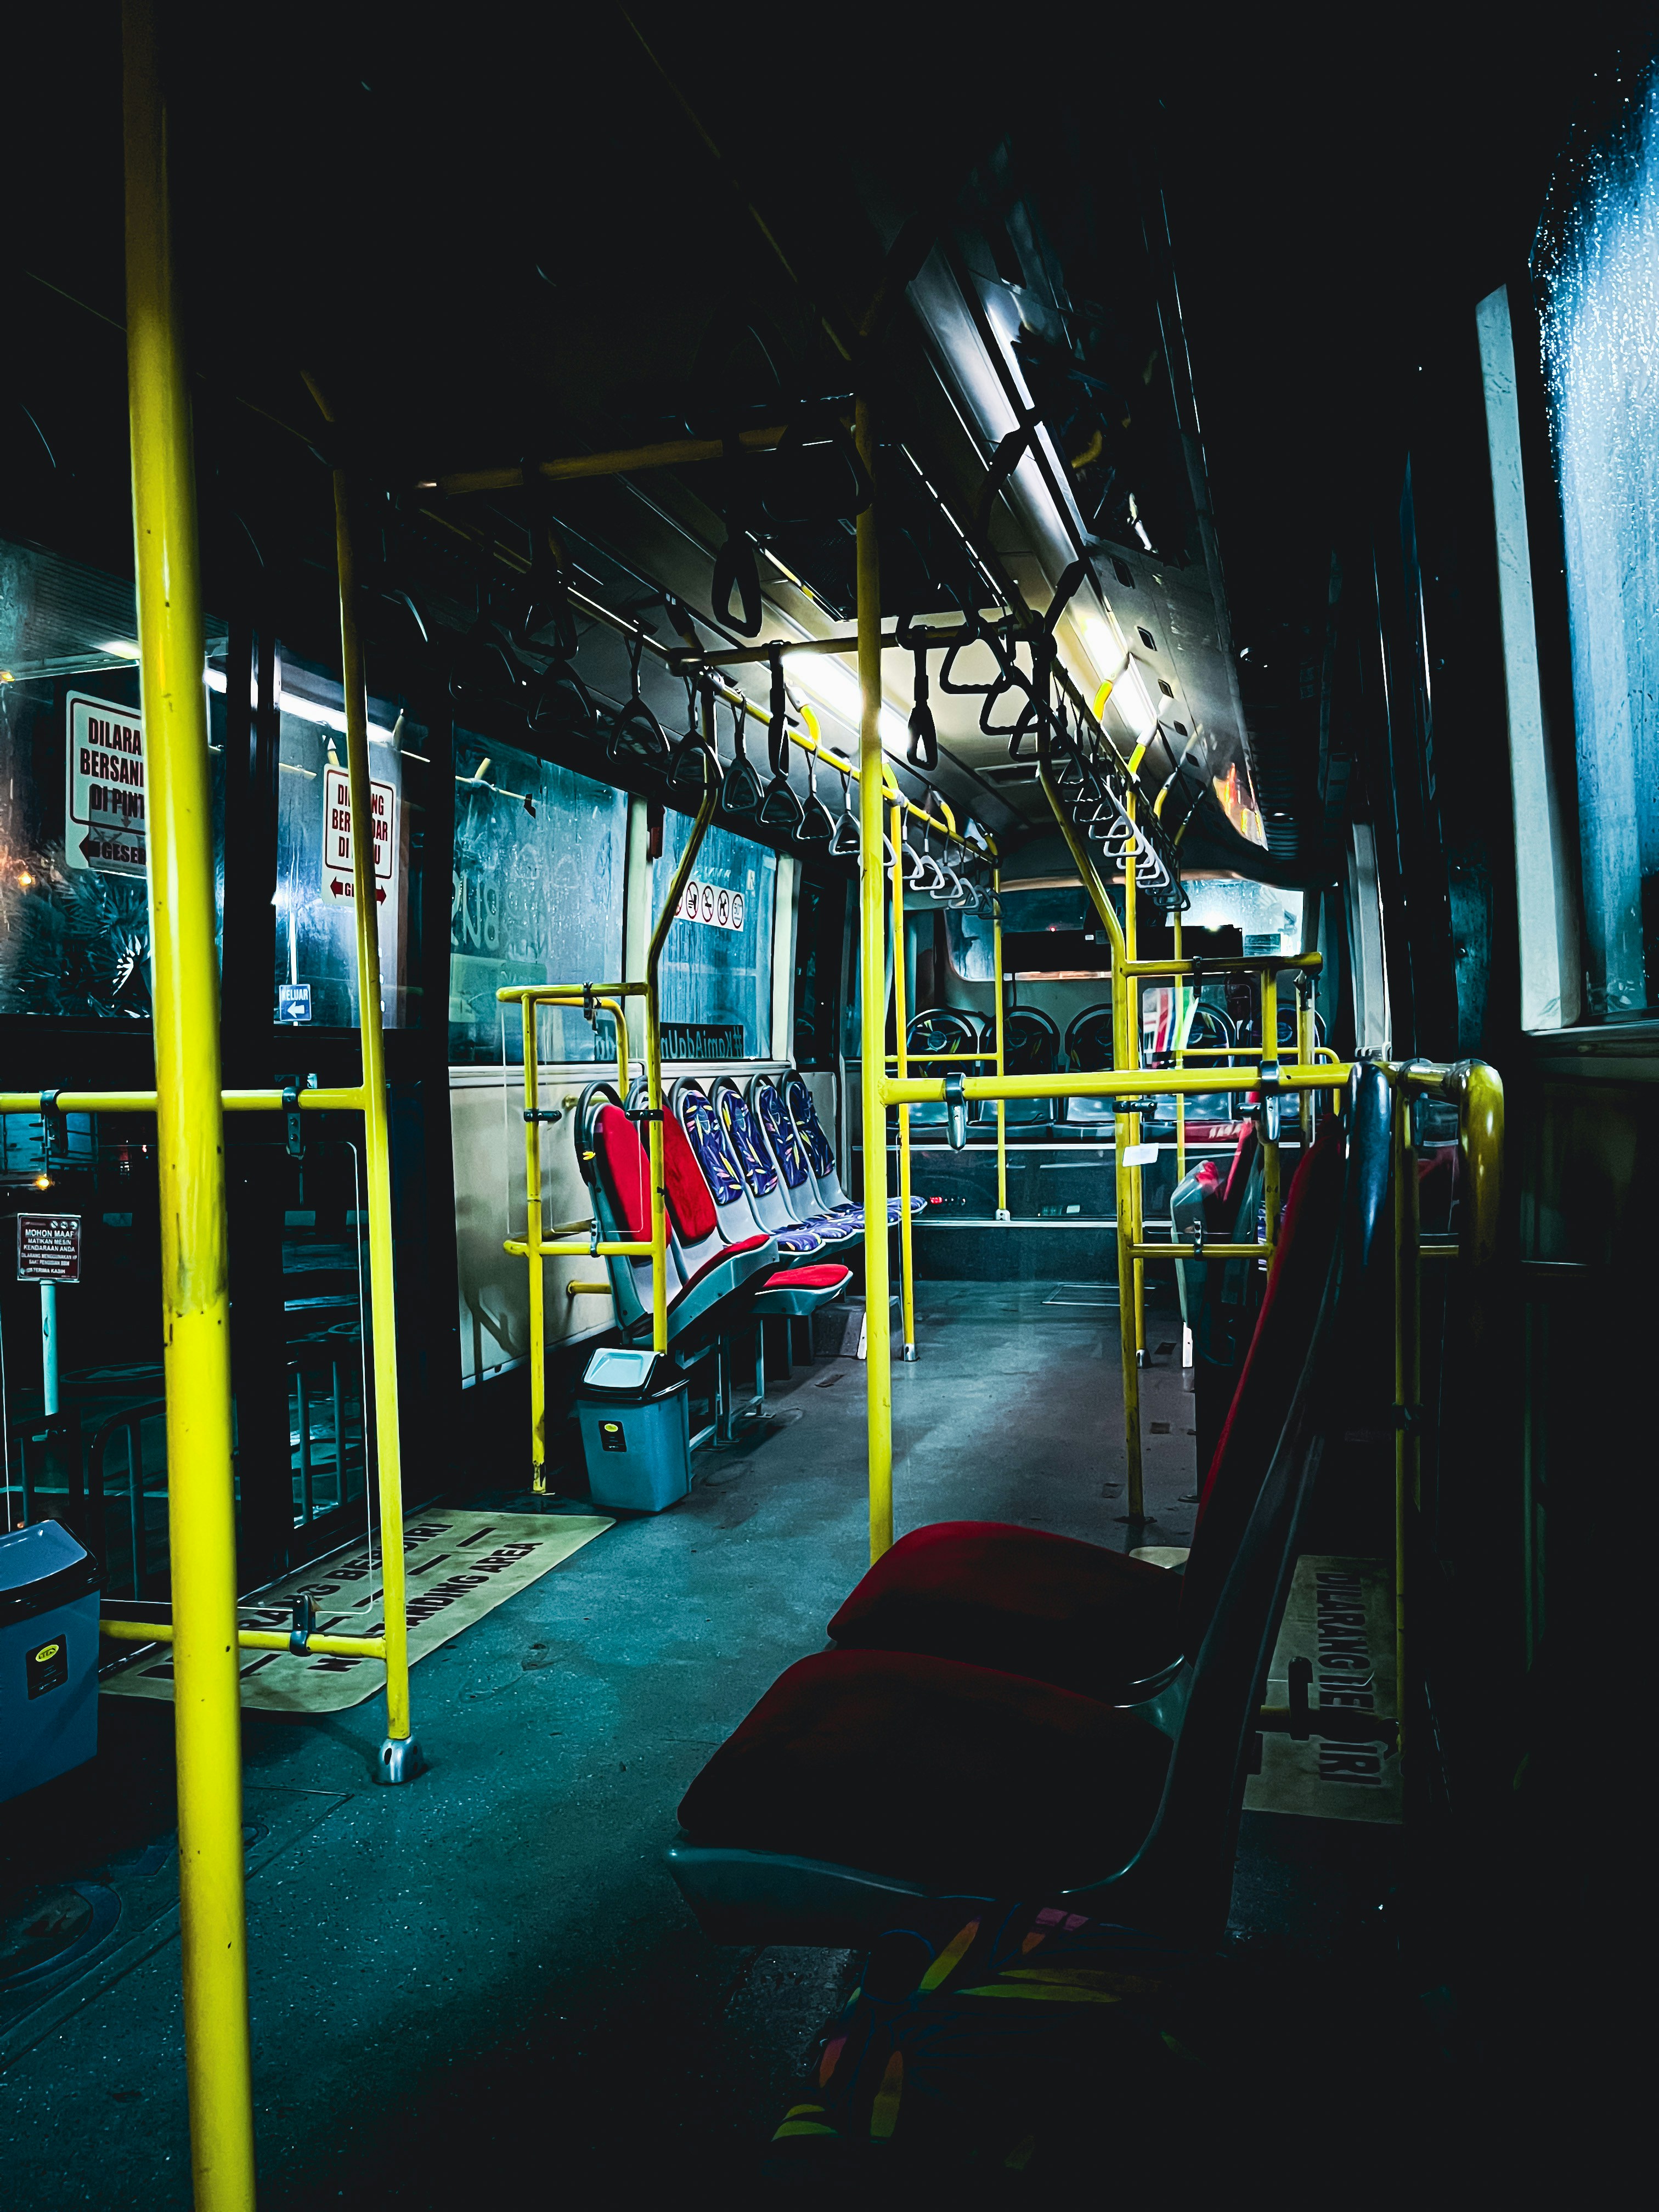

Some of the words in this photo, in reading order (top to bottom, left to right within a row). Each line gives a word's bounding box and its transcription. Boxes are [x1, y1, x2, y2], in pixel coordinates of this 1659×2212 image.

[88, 717, 142, 756] DILARA
[80, 748, 144, 787] BERSAN
[91, 784, 108, 812] DI
[111, 787, 144, 820] PINT
[25, 1229, 52, 1237] MOHON
[470, 1542, 543, 1573] AREA
[1318, 1674, 1382, 1786] BEIRI
